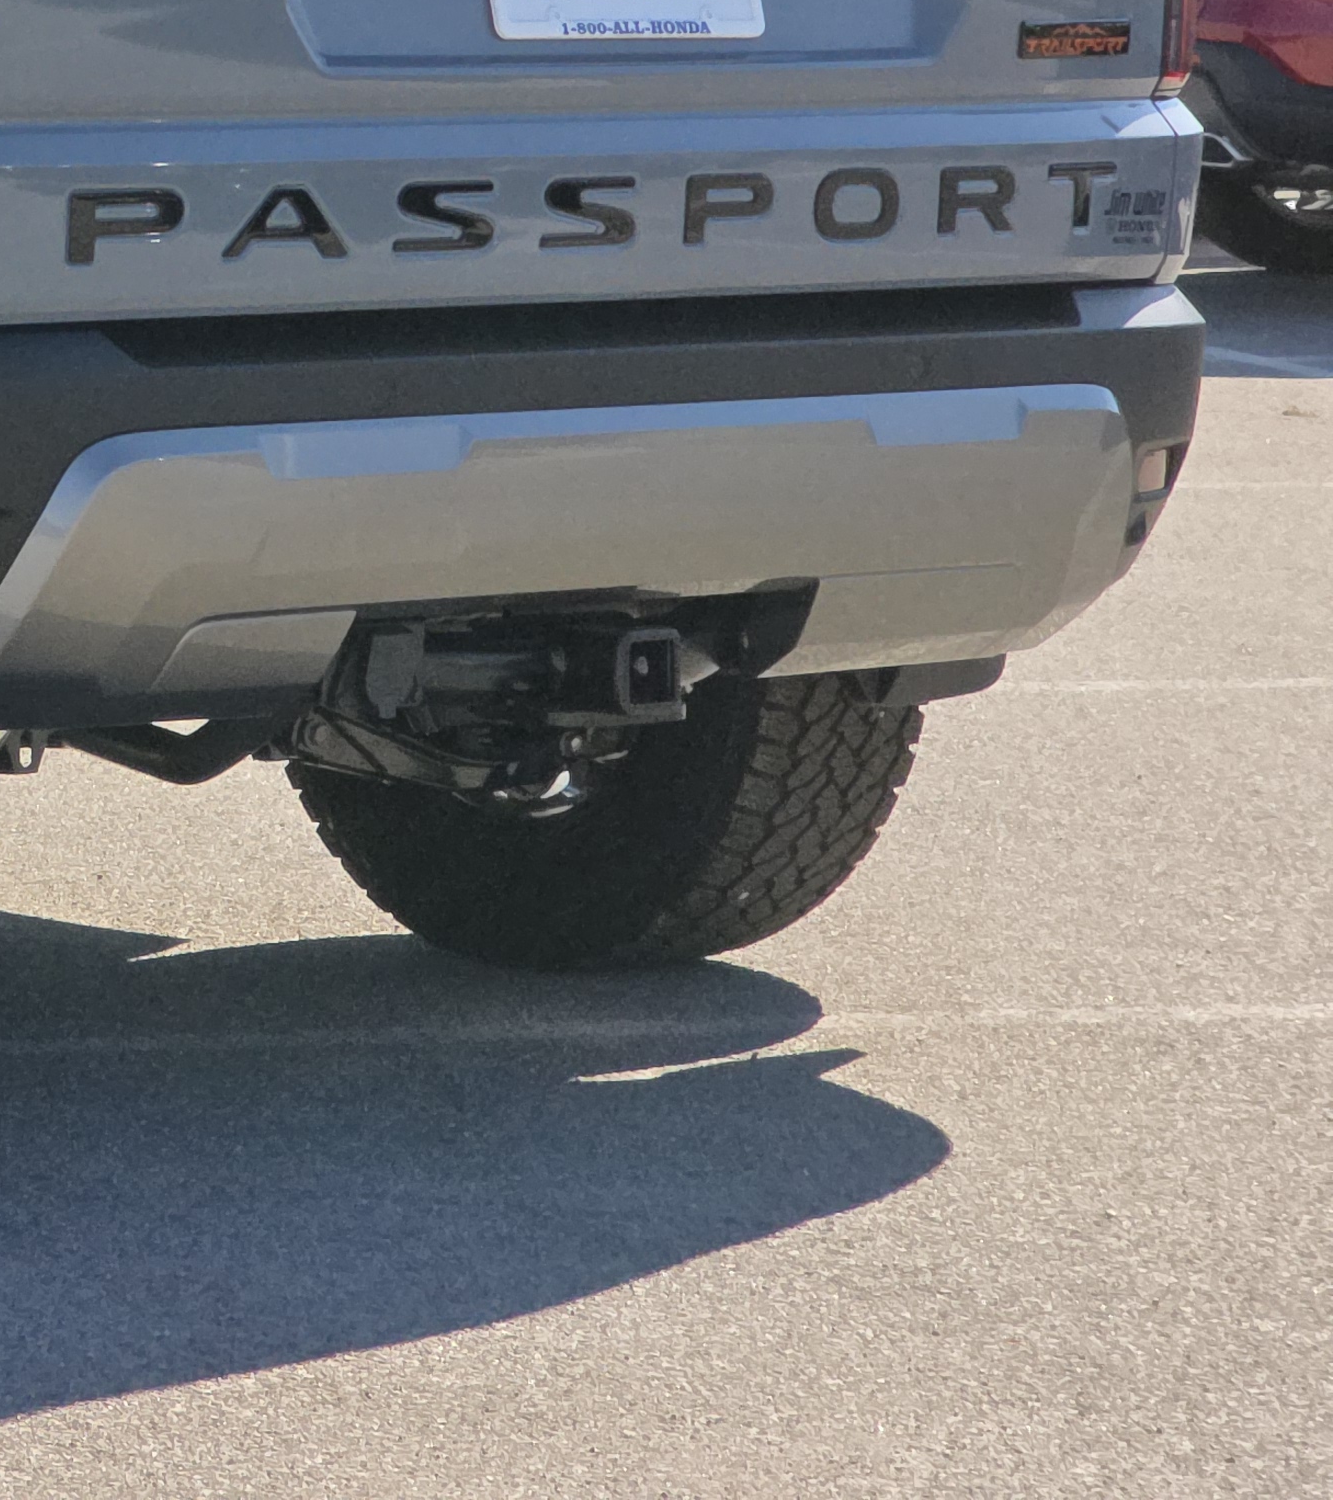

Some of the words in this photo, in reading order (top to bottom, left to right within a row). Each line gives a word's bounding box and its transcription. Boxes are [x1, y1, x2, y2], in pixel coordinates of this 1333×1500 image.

[561, 21, 712, 36] 1-800-ALL-HONDA
[1025, 35, 1129, 57] TRAILSPORT
[64, 161, 1118, 266] PASSPORT
